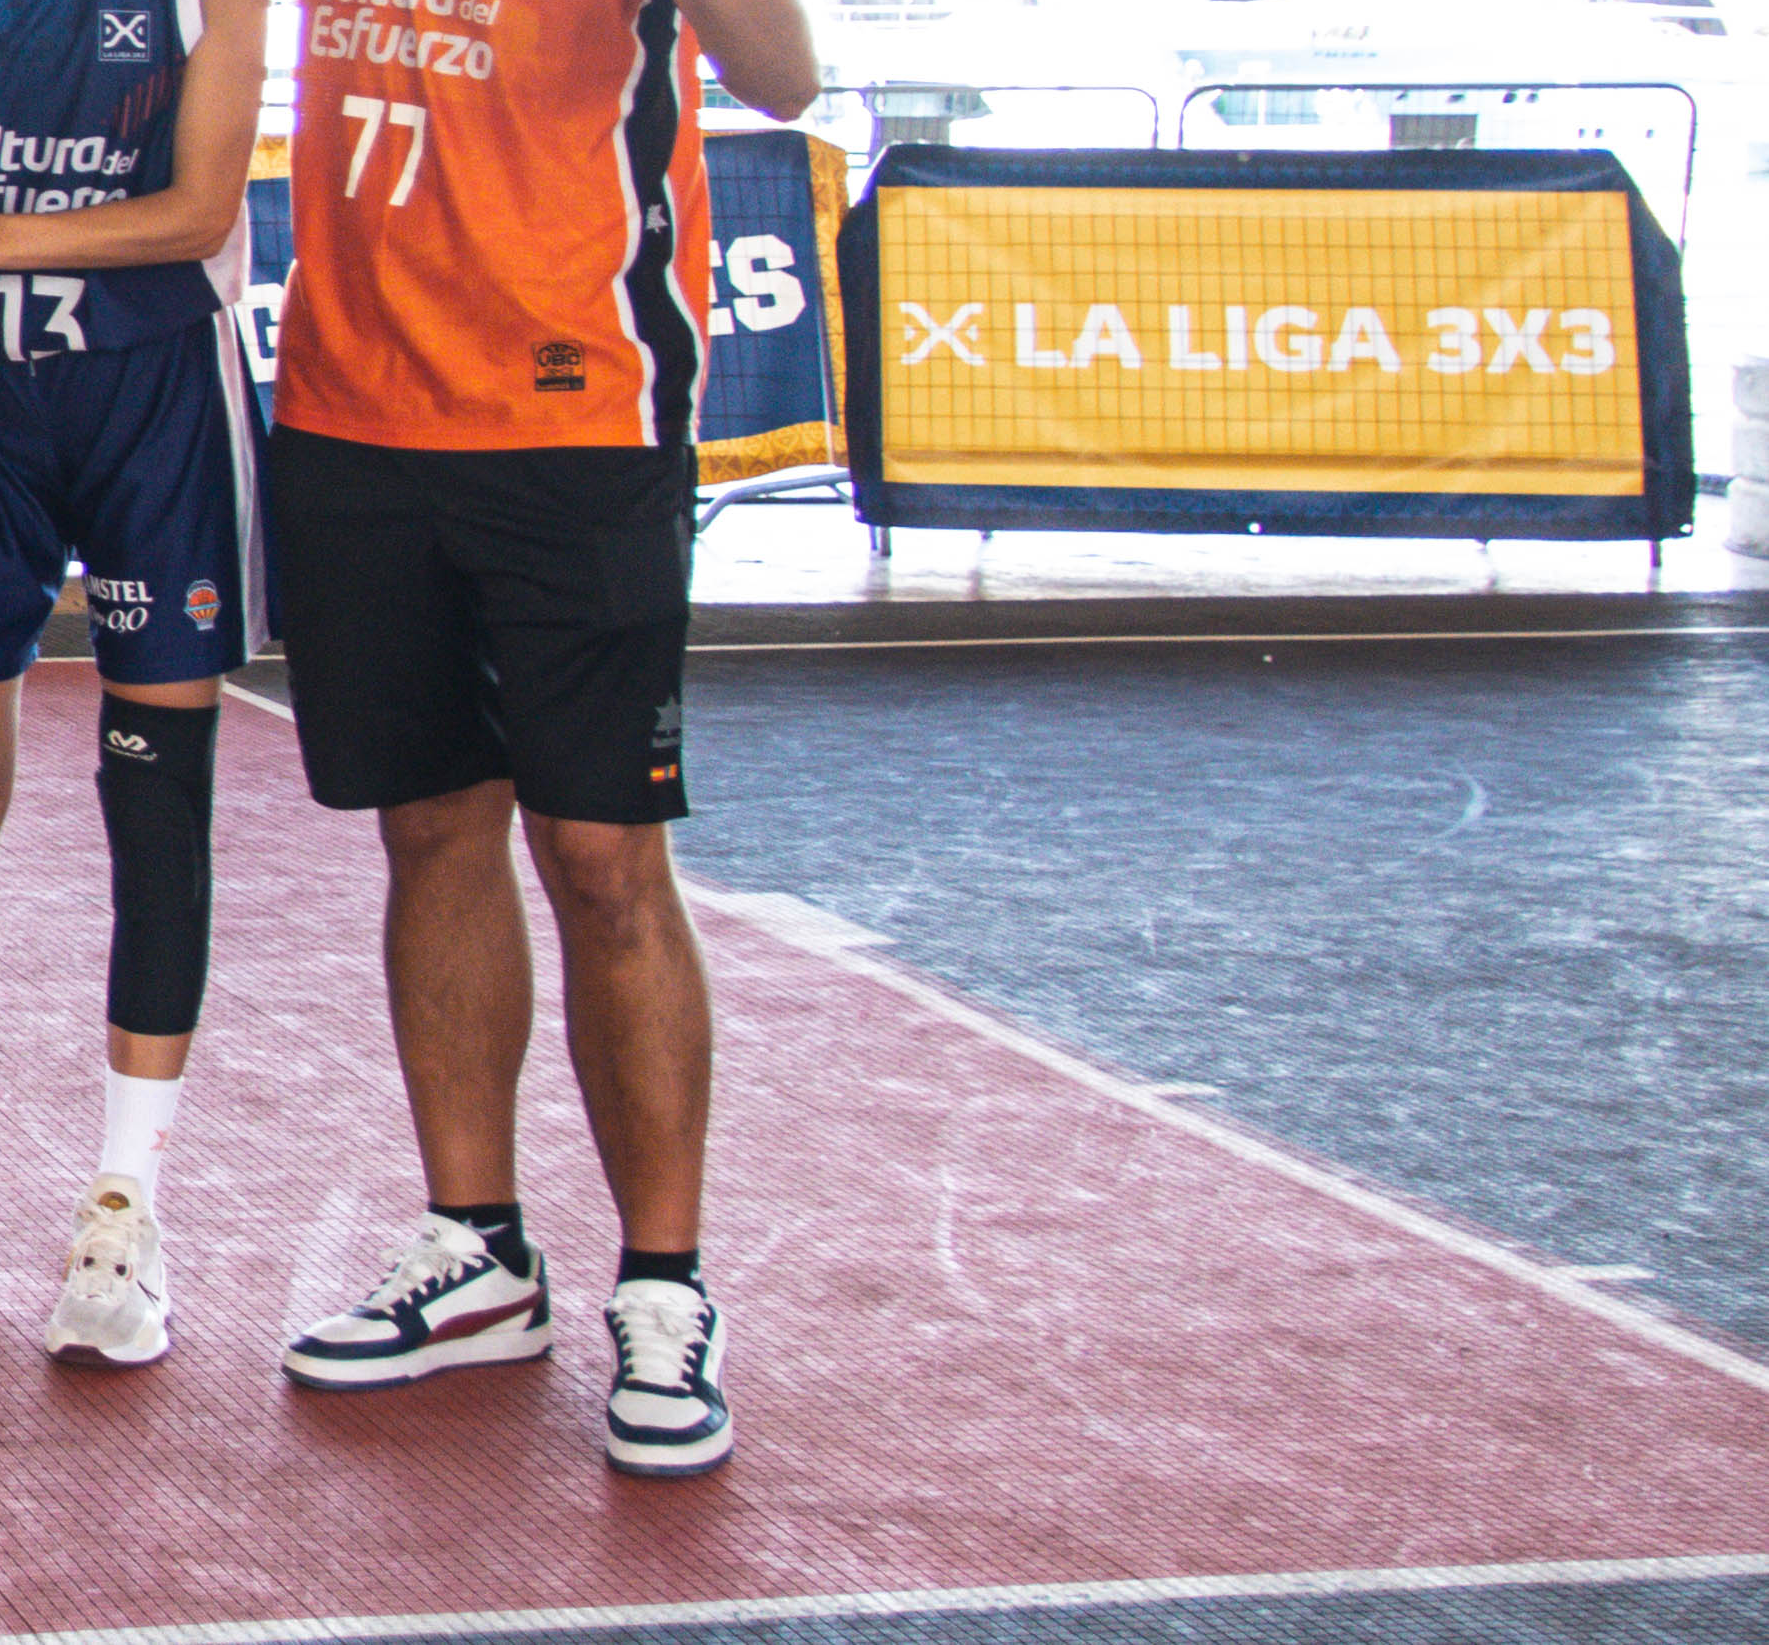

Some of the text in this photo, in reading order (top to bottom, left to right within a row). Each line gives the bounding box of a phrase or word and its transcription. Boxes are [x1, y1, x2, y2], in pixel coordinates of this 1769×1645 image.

[311, 5, 493, 80] Esfuerzo
[101, 149, 140, 176] del
[342, 94, 427, 207] 77
[1013, 302, 1616, 375] LA LIGA 3X3
